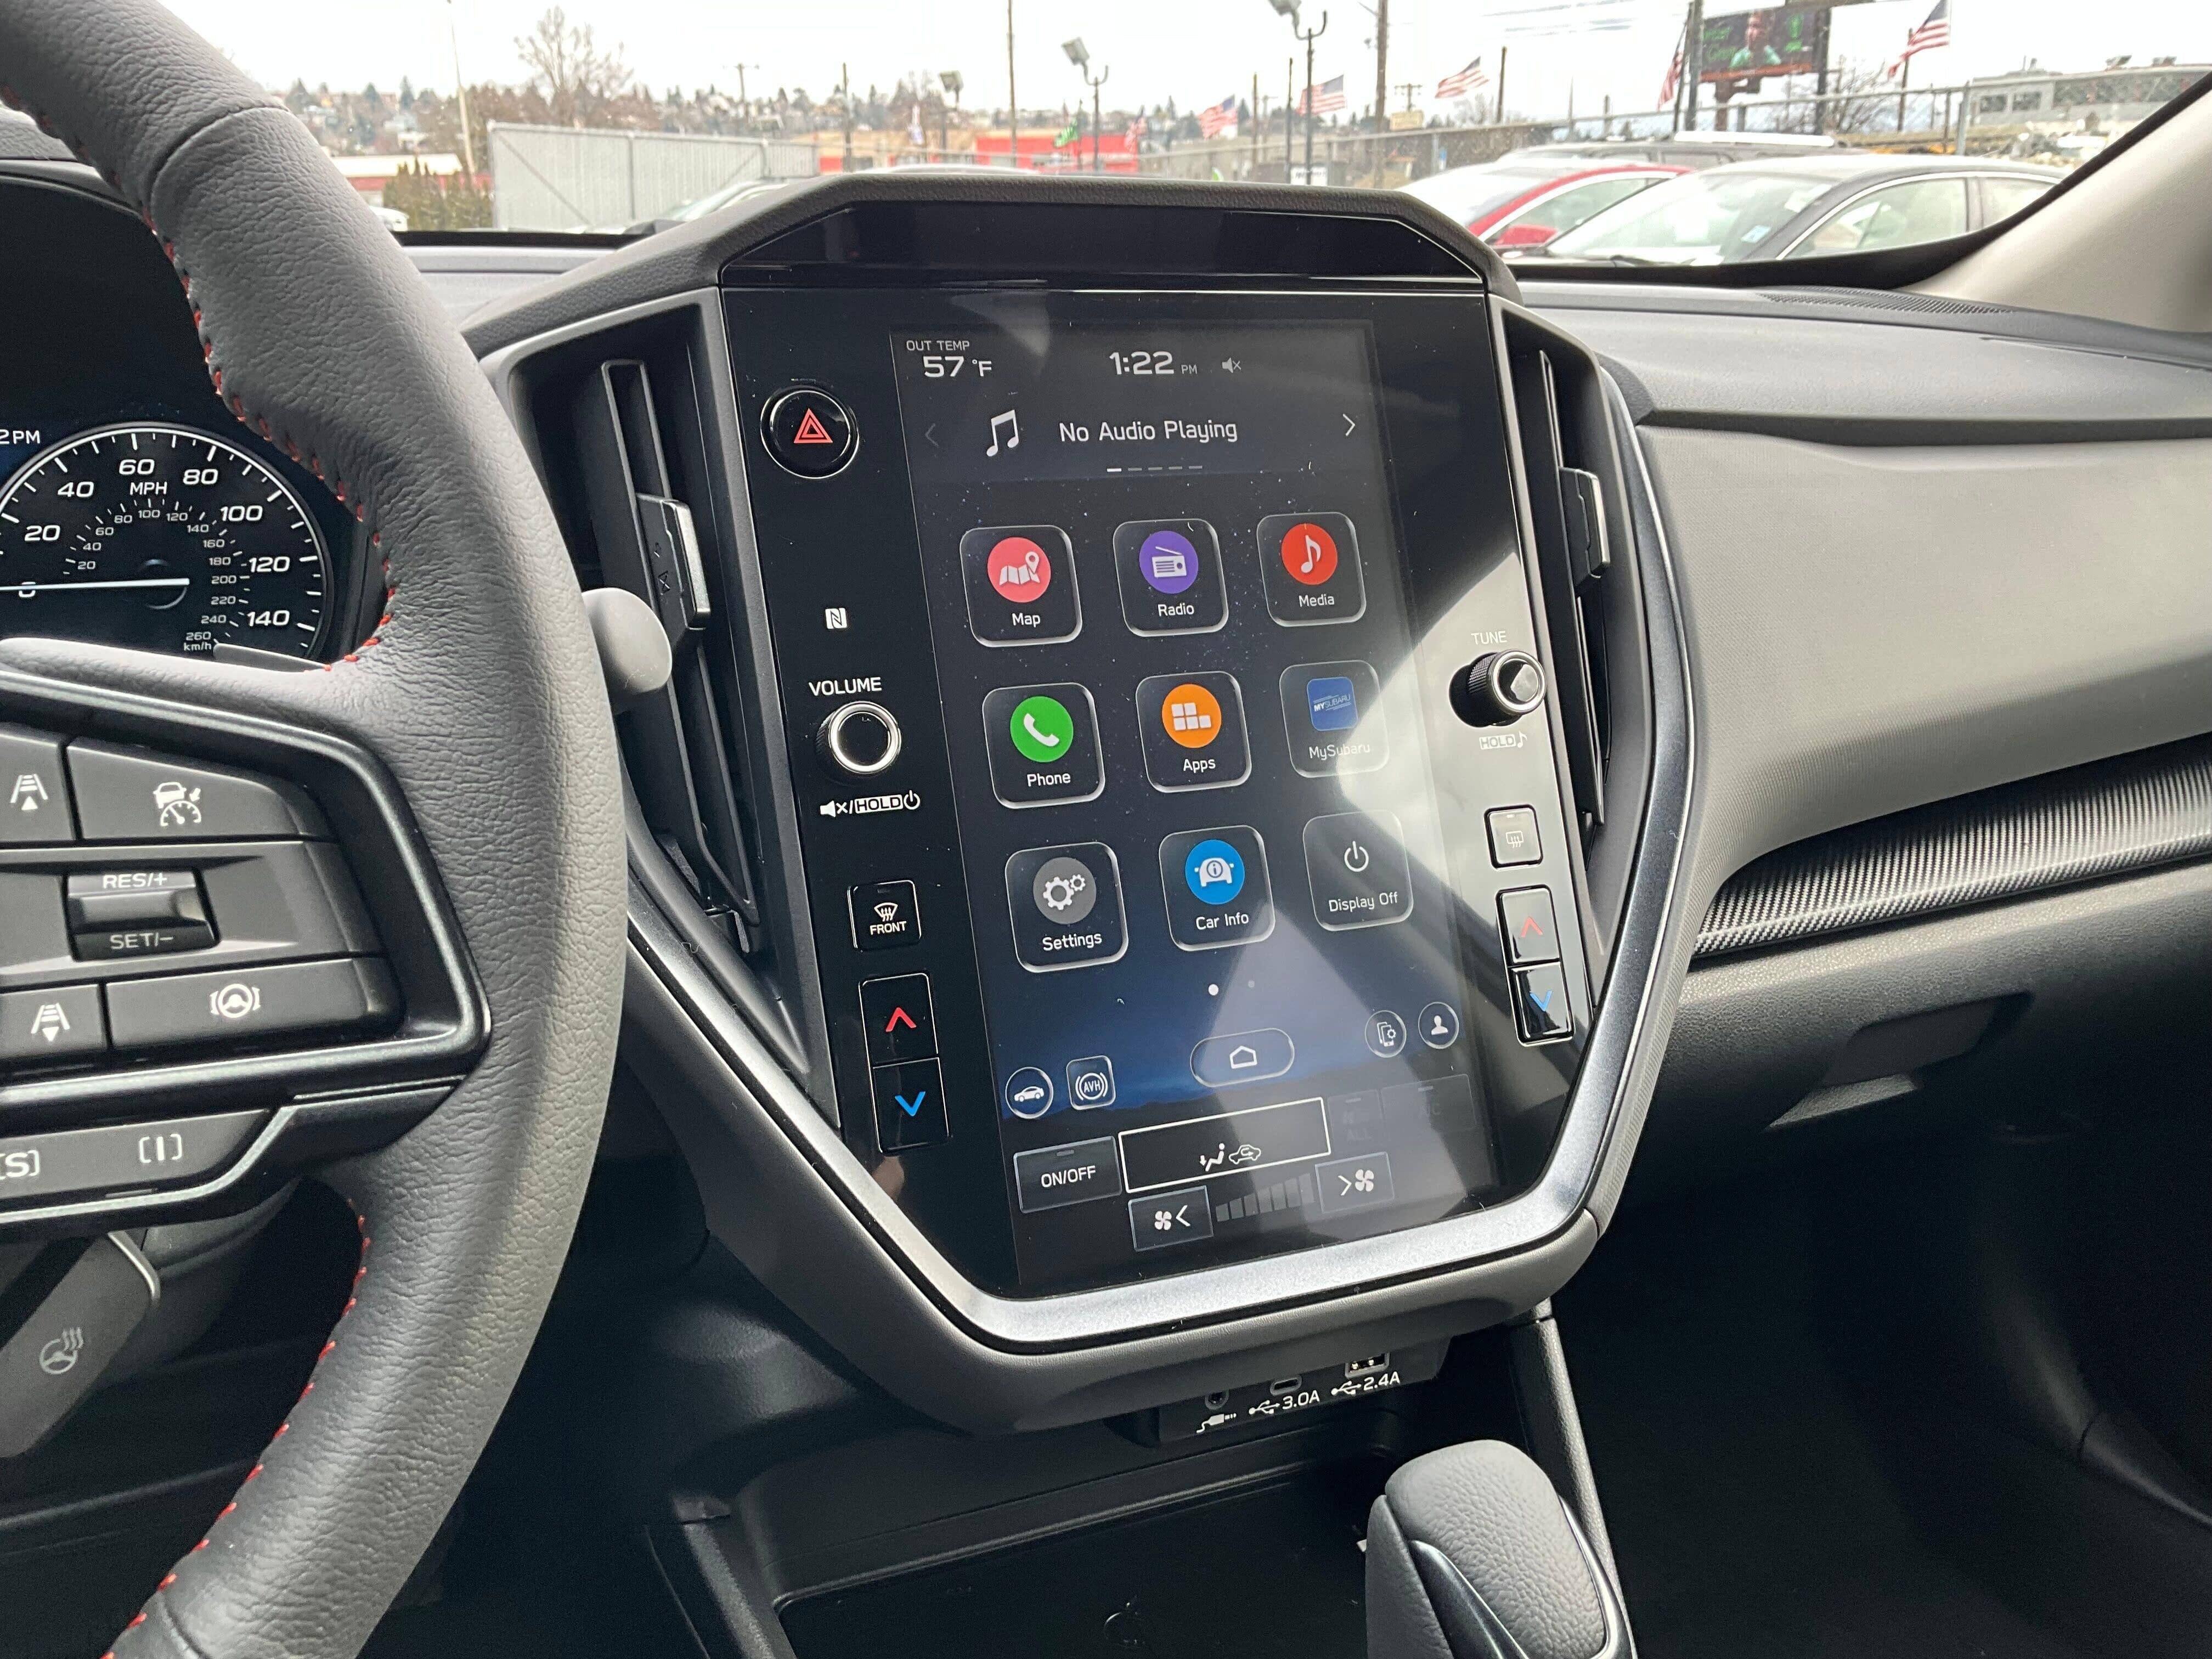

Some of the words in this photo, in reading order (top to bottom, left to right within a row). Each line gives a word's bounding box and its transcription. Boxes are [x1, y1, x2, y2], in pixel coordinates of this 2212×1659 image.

[906, 340, 932, 351] OUT
[936, 340, 970, 351] TEMP
[923, 356, 964, 378] 57
[1109, 351, 1175, 375] 1:22
[1181, 364, 1198, 374] PM
[1059, 422, 1089, 442] No
[1099, 421, 1155, 441] Audio
[1164, 419, 1238, 443] Playing
[119, 459, 155, 475] 60
[183, 469, 218, 485] 80
[57, 481, 94, 498] 40
[129, 481, 167, 495] MPH
[114, 515, 133, 524] 80
[138, 509, 161, 518] 100
[166, 512, 188, 521] 120
[220, 505, 263, 522] 100
[24, 524, 60, 541] 20
[95, 527, 114, 536] 60
[187, 524, 209, 533] 140
[82, 542, 101, 551] 40
[203, 539, 225, 548] 160
[77, 561, 96, 570] 20
[208, 556, 231, 566] 180
[249, 556, 290, 573] 120
[211, 575, 237, 584] 200
[211, 596, 236, 605] 220
[1299, 594, 1335, 607] Media
[1158, 602, 1194, 617] Radio
[201, 614, 227, 624] 240
[247, 610, 290, 627] 140
[1012, 612, 1041, 628] Map
[185, 631, 212, 641] 260
[1471, 630, 1508, 645] TUNE
[183, 641, 212, 651] km/h
[808, 676, 882, 696] VOLUME
[1309, 743, 1370, 760] MySubaru
[1183, 758, 1216, 774] Apps
[1026, 773, 1071, 787] Phone
[1328, 896, 1375, 912] Display
[1379, 891, 1398, 905] Off
[870, 921, 907, 935] FRONT
[1195, 916, 1220, 930] Car
[1224, 912, 1249, 926] Info
[1042, 933, 1102, 951] Settings
[1084, 1080, 1101, 1093] AVH
[1041, 1165, 1096, 1188] ON/OFF
[1363, 1371, 1401, 1391] 2.4A
[1282, 1390, 1320, 1410] 3.0A
